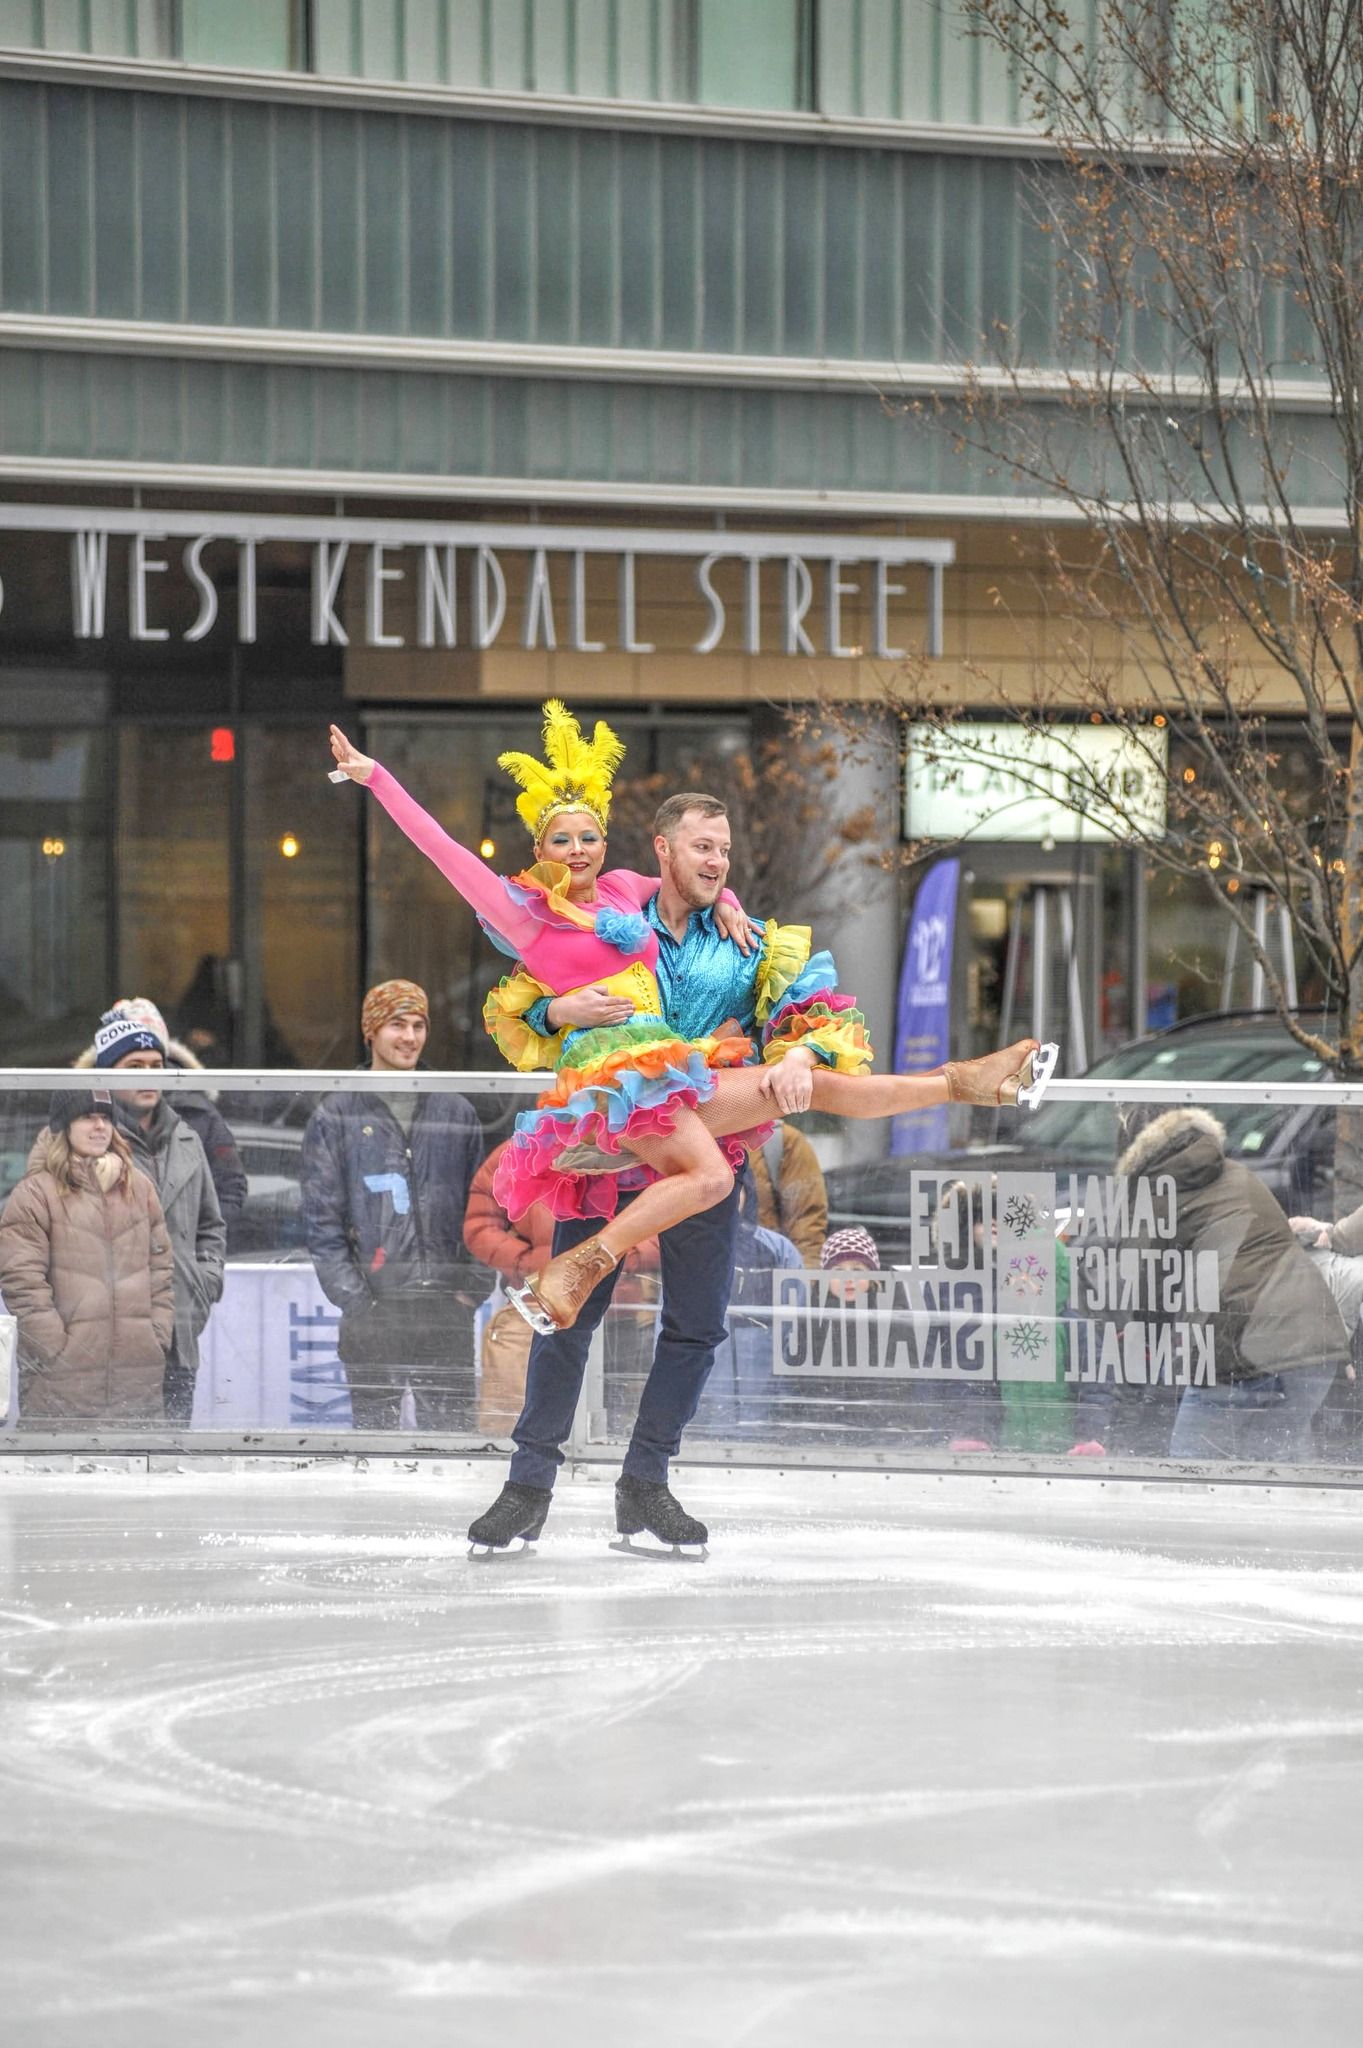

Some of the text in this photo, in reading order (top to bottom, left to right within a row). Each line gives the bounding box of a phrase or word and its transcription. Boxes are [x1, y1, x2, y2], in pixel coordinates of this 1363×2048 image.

[72, 530, 949, 660] WEST KENDALL STREET
